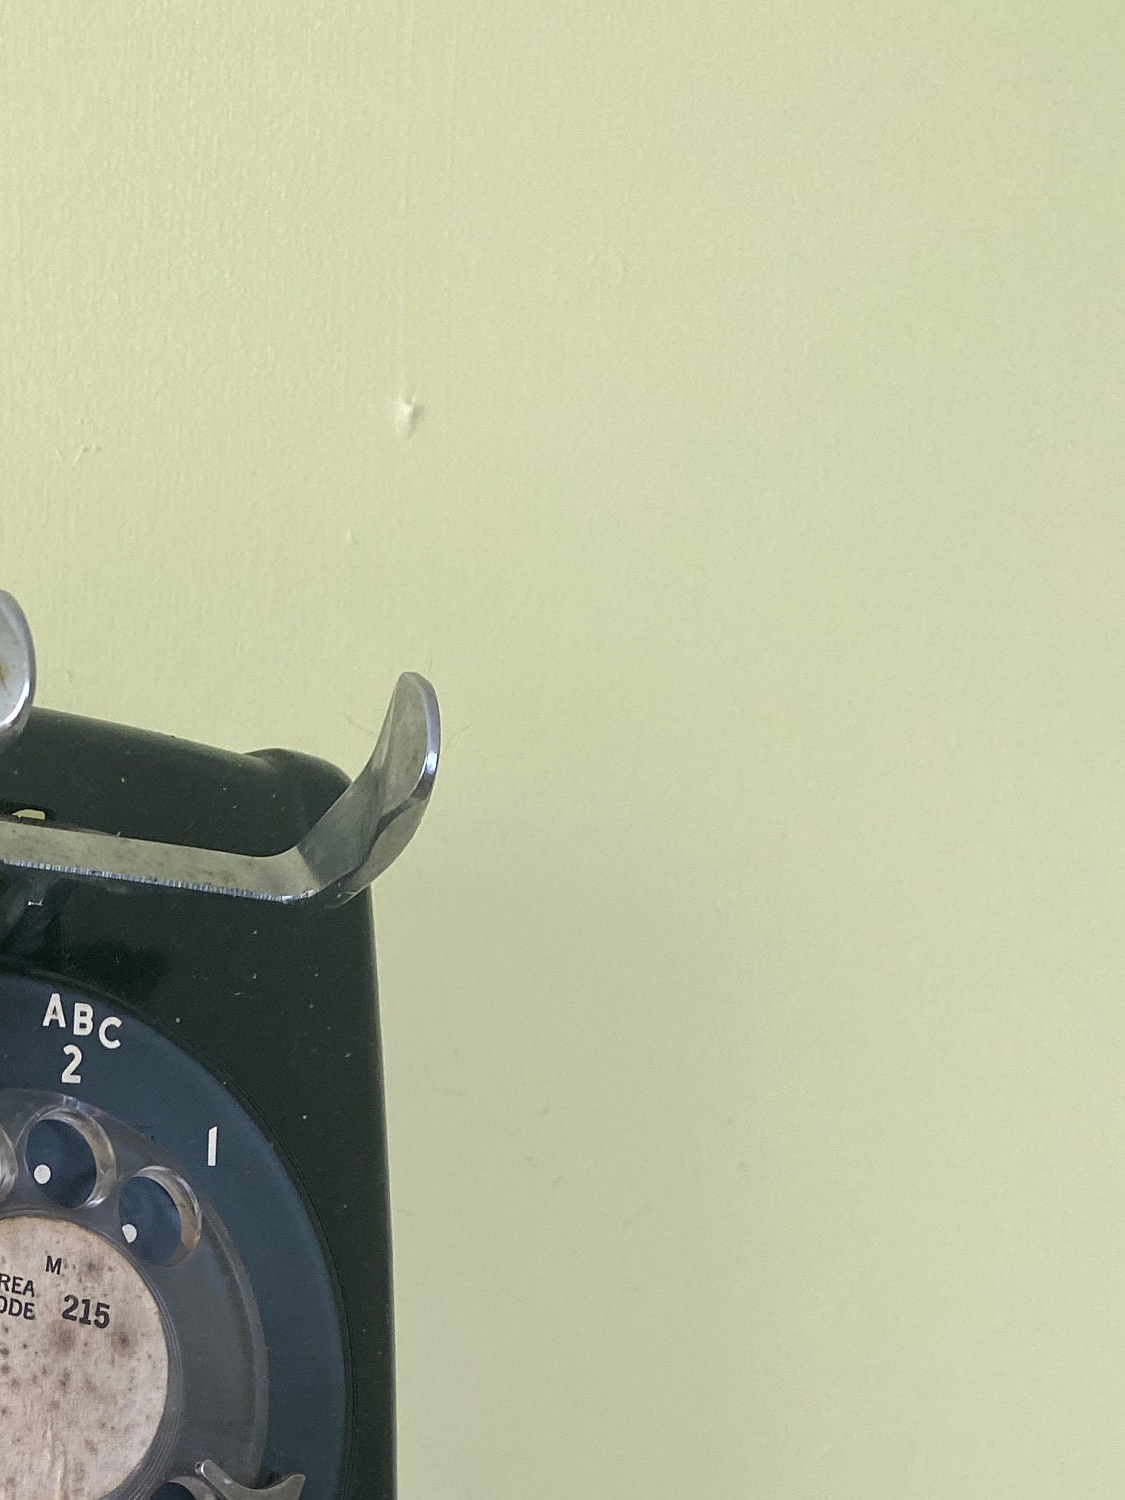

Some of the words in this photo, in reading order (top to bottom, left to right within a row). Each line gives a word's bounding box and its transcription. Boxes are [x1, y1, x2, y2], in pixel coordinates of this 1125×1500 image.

[42, 992, 123, 1050] ABC
[61, 1045, 83, 1084] 2
[45, 1255, 62, 1275] M
[62, 1294, 111, 1329] 215
